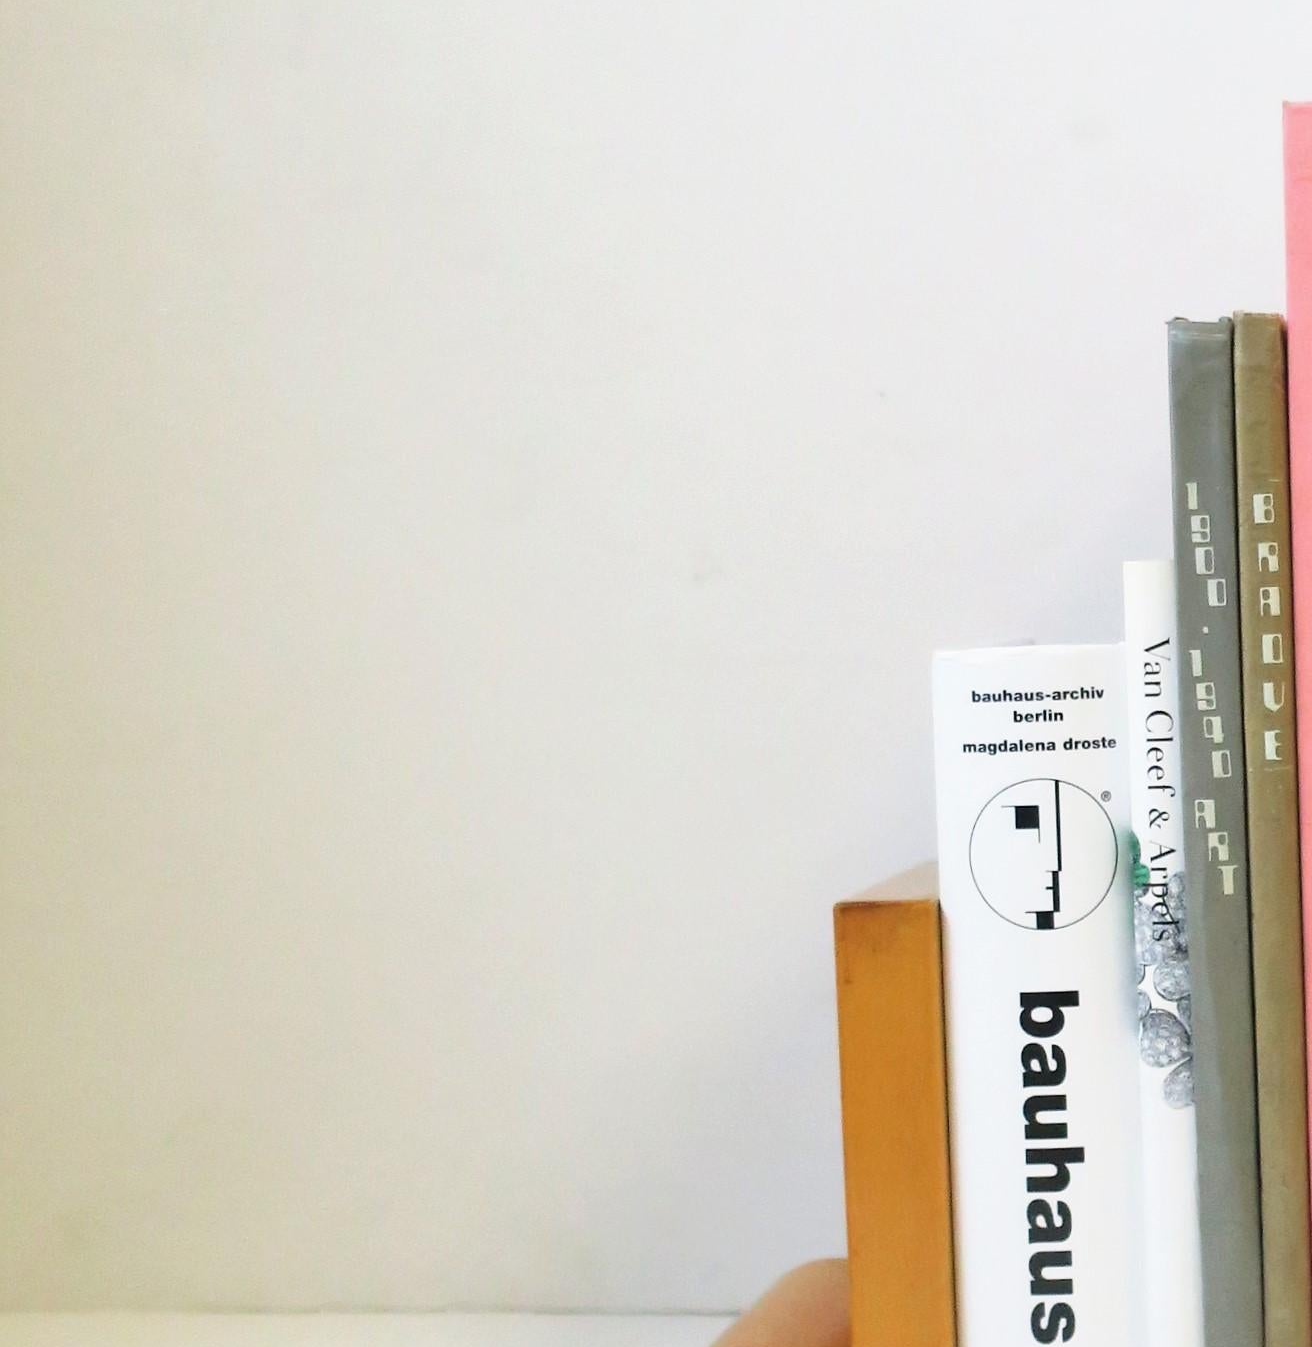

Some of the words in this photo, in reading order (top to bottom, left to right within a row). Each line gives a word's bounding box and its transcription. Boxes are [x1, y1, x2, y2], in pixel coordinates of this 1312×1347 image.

[1186, 482, 1227, 607] 1900
[971, 686, 1105, 703] bauhaus-archiv
[1143, 636, 1171, 698] Van
[962, 738, 1057, 756] magdalena
[1062, 736, 1117, 751] droste
[1012, 708, 1064, 724] berlin
[1145, 709, 1176, 798] Cleef
[1148, 808, 1170, 829] &
[1194, 799, 1238, 895] ART
[1143, 840, 1180, 943] Arpels
[1019, 990, 1085, 1345] bauhaus
